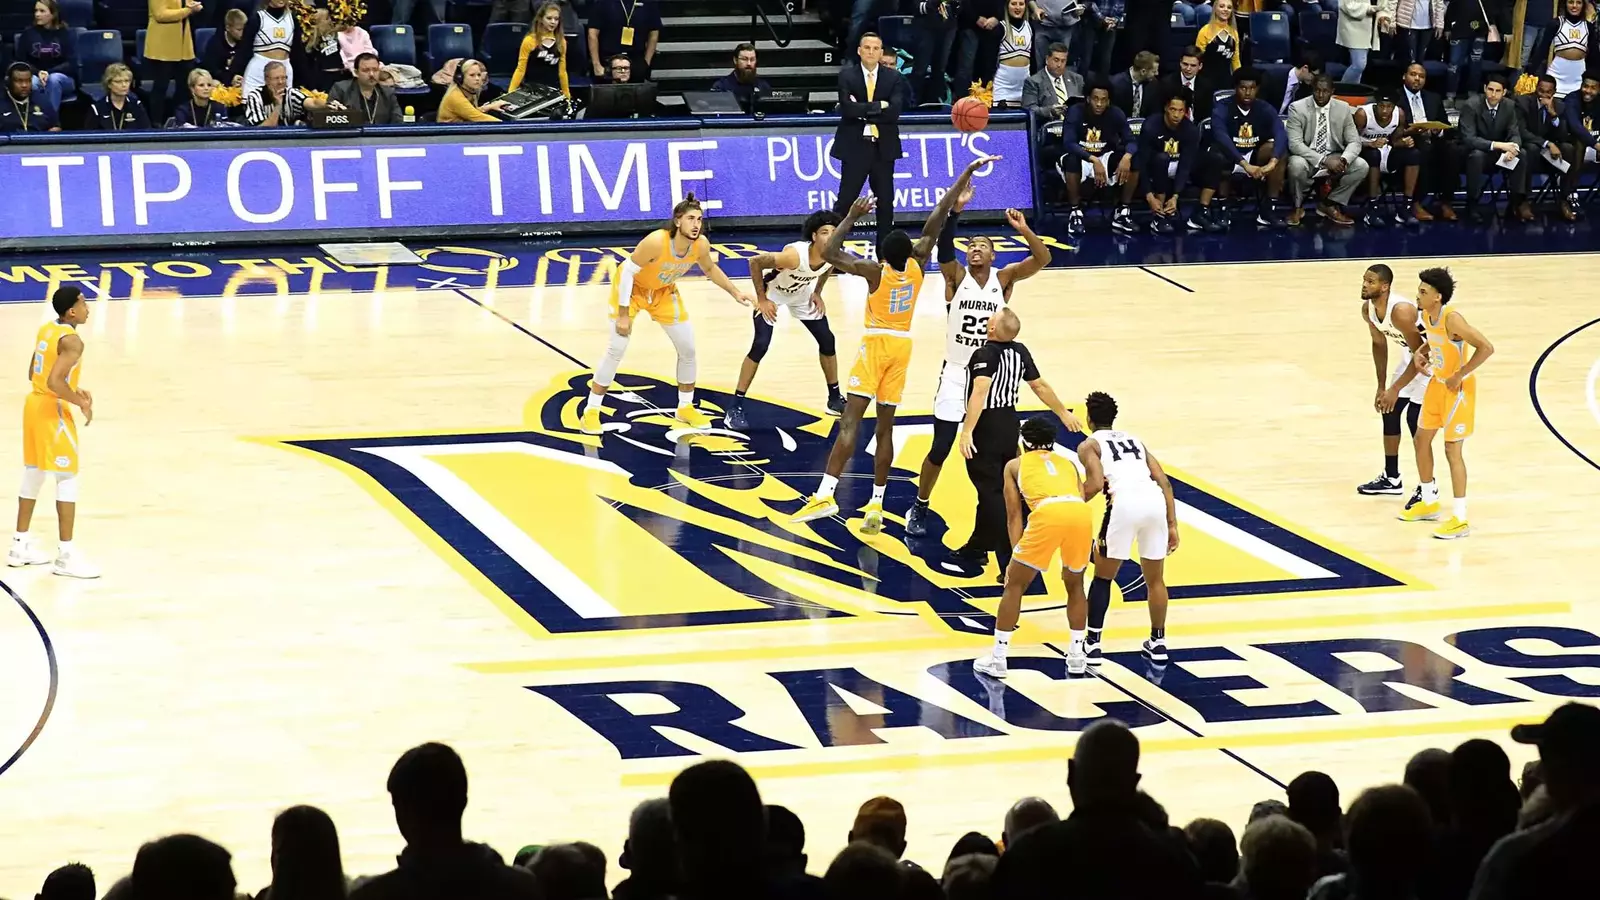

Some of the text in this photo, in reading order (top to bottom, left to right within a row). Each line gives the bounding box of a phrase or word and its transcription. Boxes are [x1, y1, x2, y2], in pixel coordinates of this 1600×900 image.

[786, 2, 794, 12] C
[273, 27, 285, 38] M
[1569, 29, 1580, 39] M
[1015, 36, 1025, 46] M
[824, 53, 832, 63] B
[326, 115, 349, 124] POSS.
[767, 133, 994, 182] PUCETT'S
[21, 141, 723, 227] TIP OFF TIME
[99, 261, 213, 278] TO
[889, 284, 914, 315] 12
[958, 300, 998, 313] MURRAY
[961, 315, 989, 335] 23
[955, 334, 988, 348] STAT
[1105, 439, 1142, 461] 14
[1044, 460, 1059, 476] 1
[524, 626, 1600, 759] RACERS
